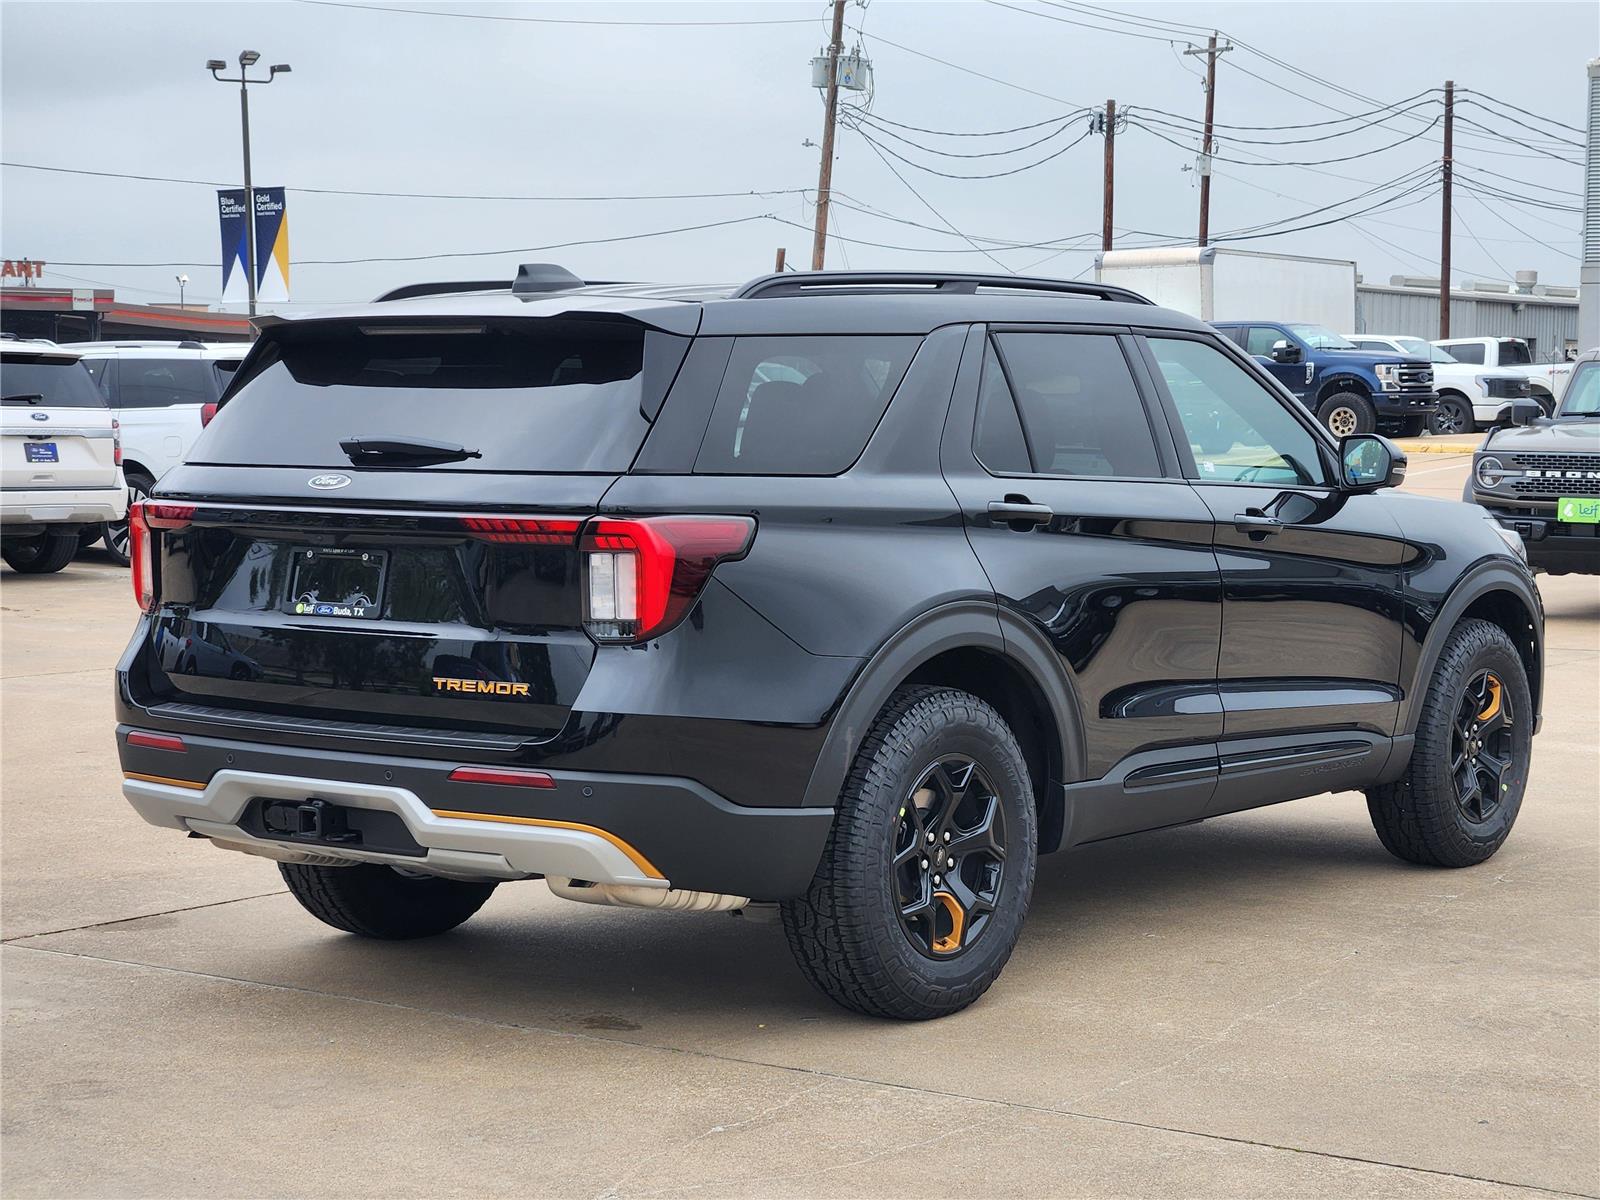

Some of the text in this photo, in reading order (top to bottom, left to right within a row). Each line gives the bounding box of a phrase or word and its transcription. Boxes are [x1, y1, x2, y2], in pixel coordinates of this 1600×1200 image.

[220, 197, 235, 205] Blue
[256, 194, 270, 203] Gold
[221, 204, 246, 213] Certified
[256, 202, 282, 211] Certified
[1, 260, 46, 278] ANT
[333, 607, 352, 616] Buda,
[353, 607, 364, 616] TX
[432, 677, 530, 696] TREMOR
